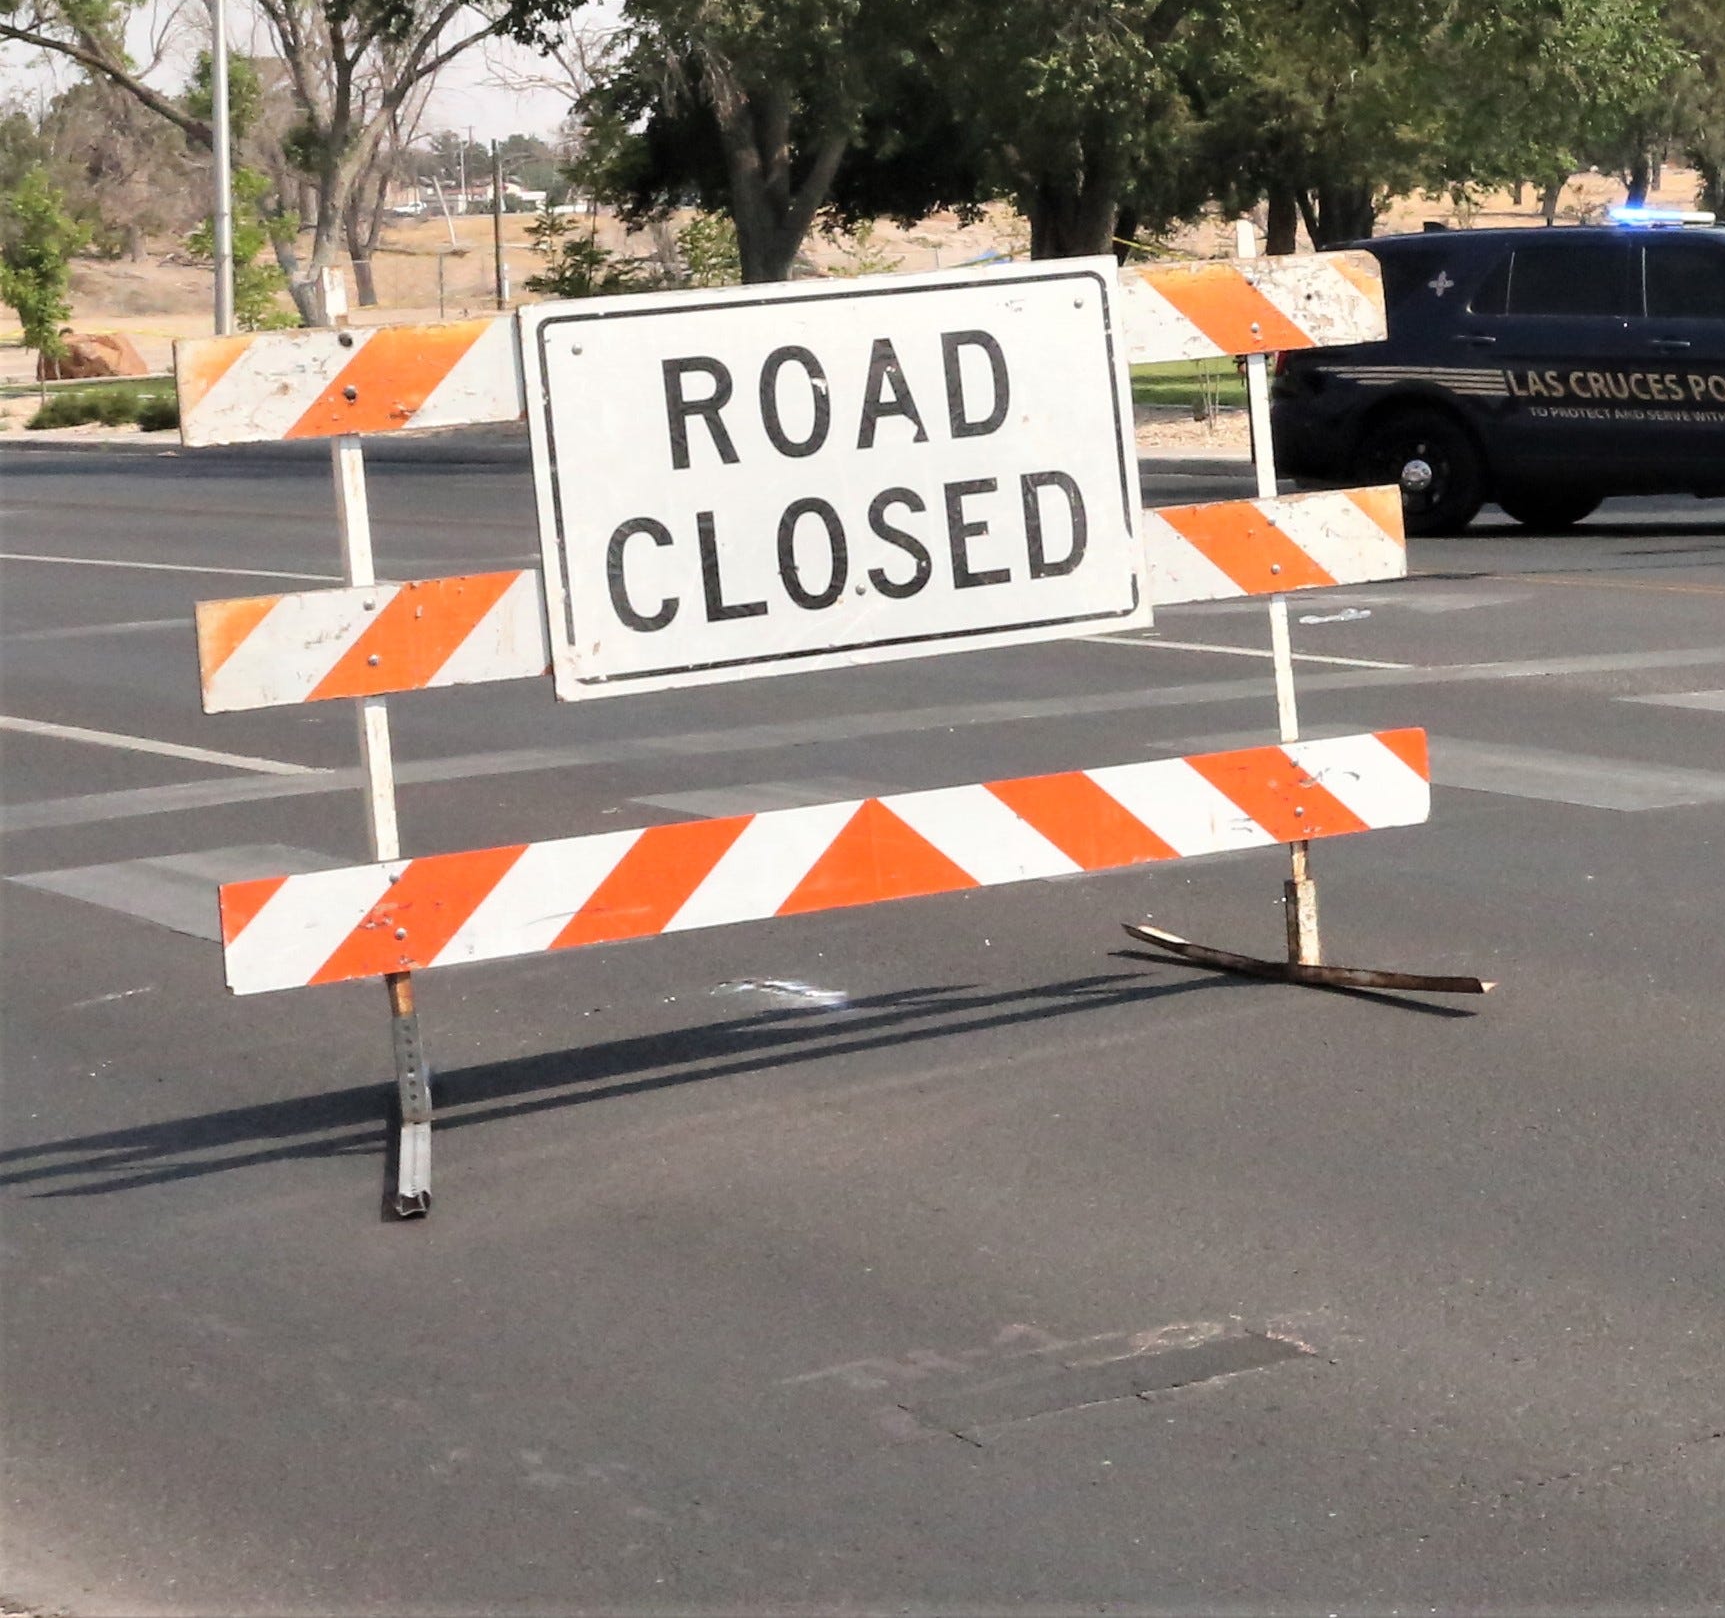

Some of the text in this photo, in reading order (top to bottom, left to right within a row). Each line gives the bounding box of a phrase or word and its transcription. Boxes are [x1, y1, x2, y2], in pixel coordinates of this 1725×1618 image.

[661, 329, 1011, 470] ROAD
[1506, 370, 1565, 398] LAS
[1569, 371, 1685, 401] CRUCES
[1529, 406, 1549, 417] TO
[1550, 407, 1611, 419] PROTECT
[1614, 409, 1644, 420] AND
[1646, 410, 1690, 422] SERVE
[606, 470, 1088, 633] CLOSED
